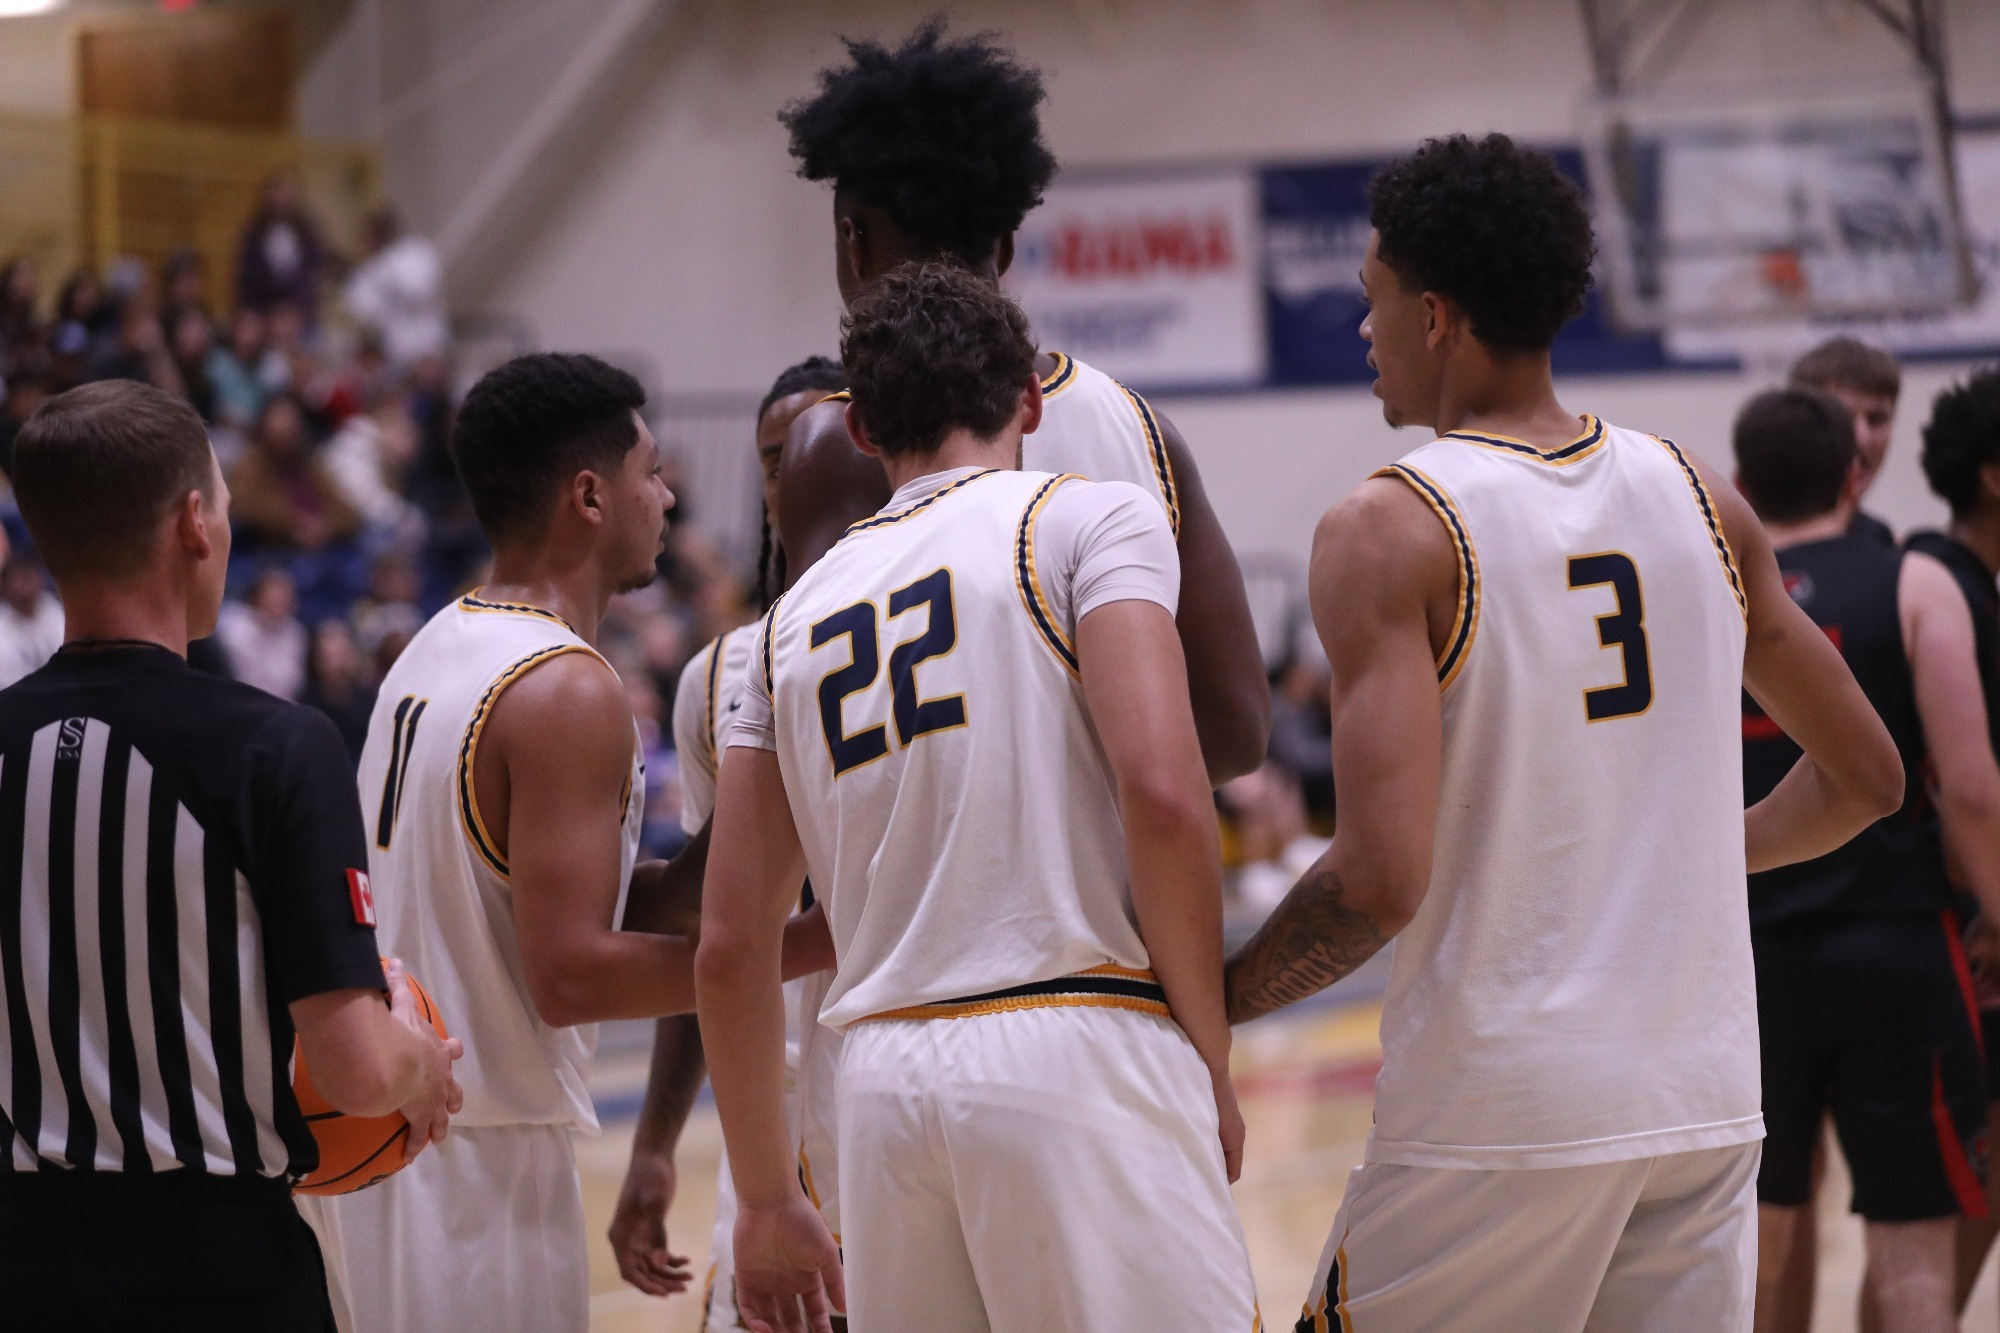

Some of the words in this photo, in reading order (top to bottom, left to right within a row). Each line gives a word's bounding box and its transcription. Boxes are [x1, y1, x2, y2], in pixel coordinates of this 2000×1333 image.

[808, 565, 969, 782] 22
[1567, 550, 1655, 724] 3
[376, 693, 430, 851] 11
